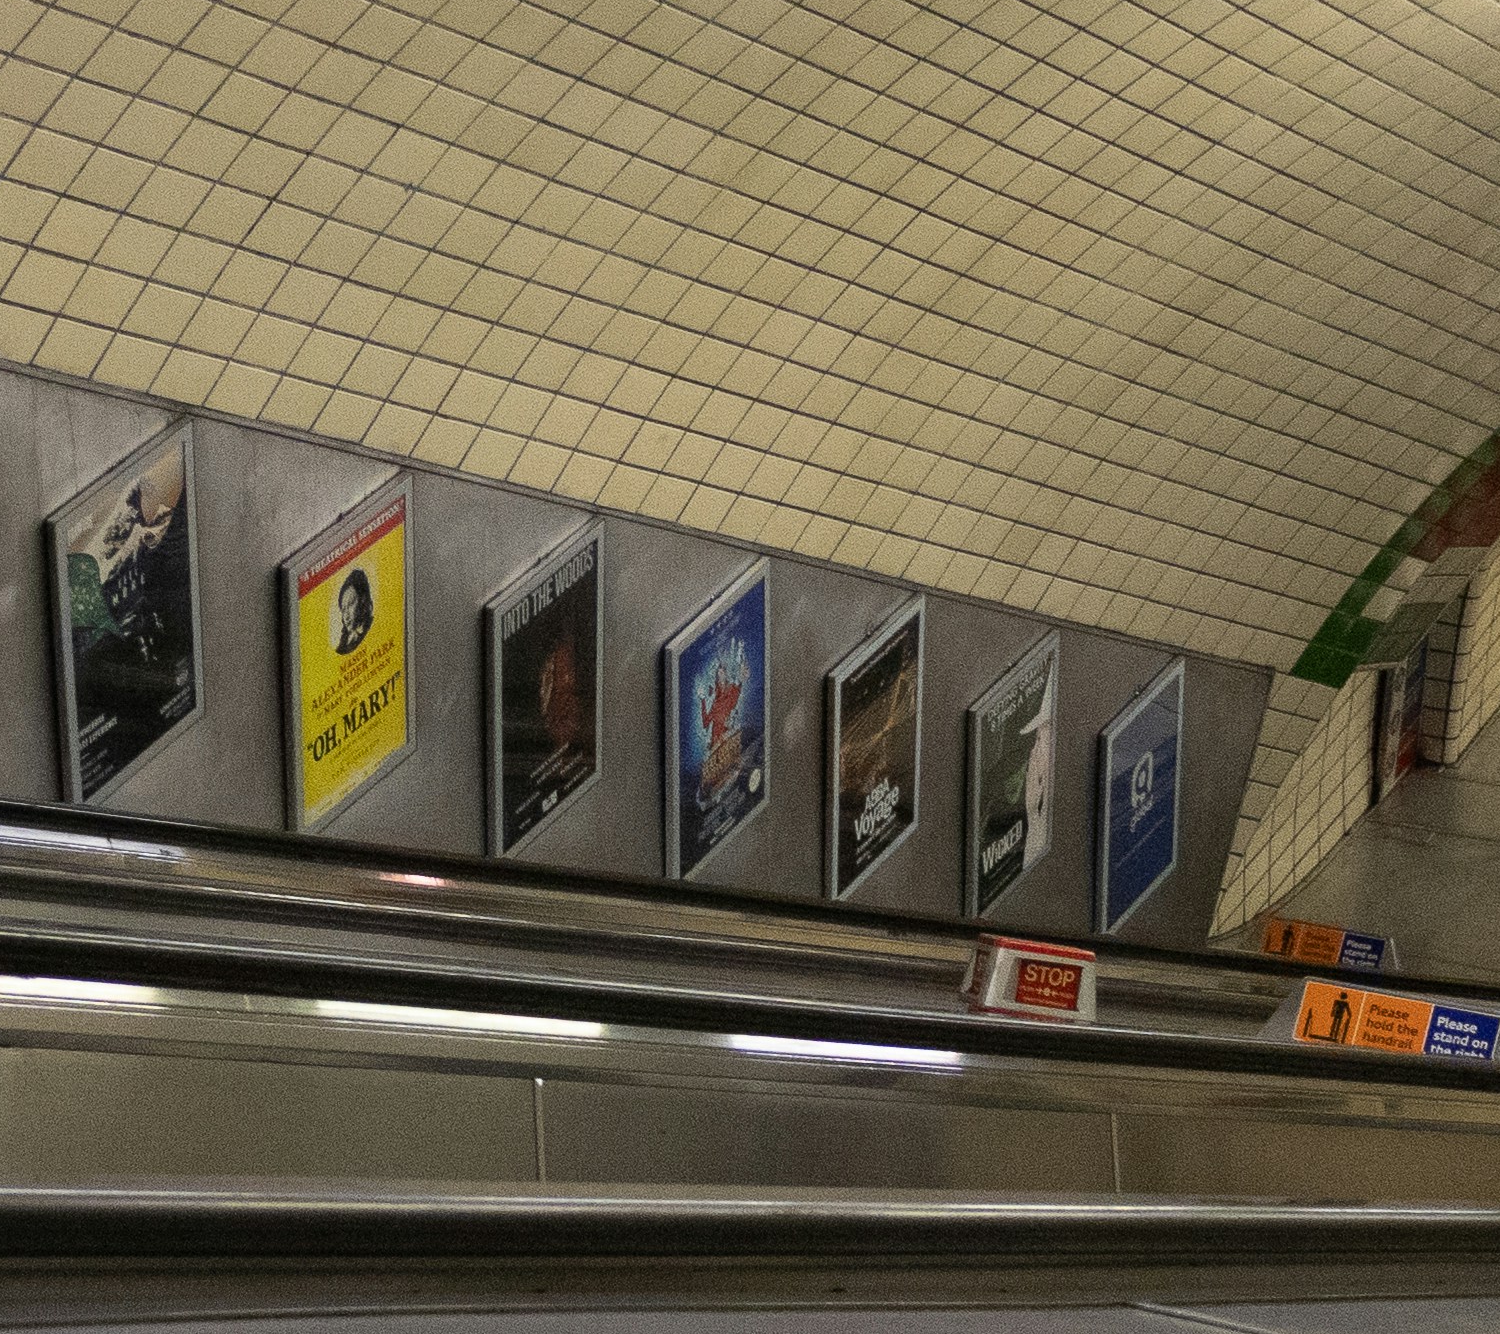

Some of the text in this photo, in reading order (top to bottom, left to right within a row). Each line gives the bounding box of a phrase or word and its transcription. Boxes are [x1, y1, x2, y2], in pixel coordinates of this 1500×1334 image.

[502, 548, 594, 641] INTO THE WOODS
[854, 786, 900, 842] Voyage
[982, 820, 1023, 874] WICKED
[1023, 961, 1075, 989] STOP
[1369, 1003, 1410, 1022] Please
[1366, 1017, 1418, 1037] hold the
[1436, 1016, 1478, 1035] Please
[1362, 1031, 1412, 1051] handrail
[1433, 1030, 1488, 1050] stand on
